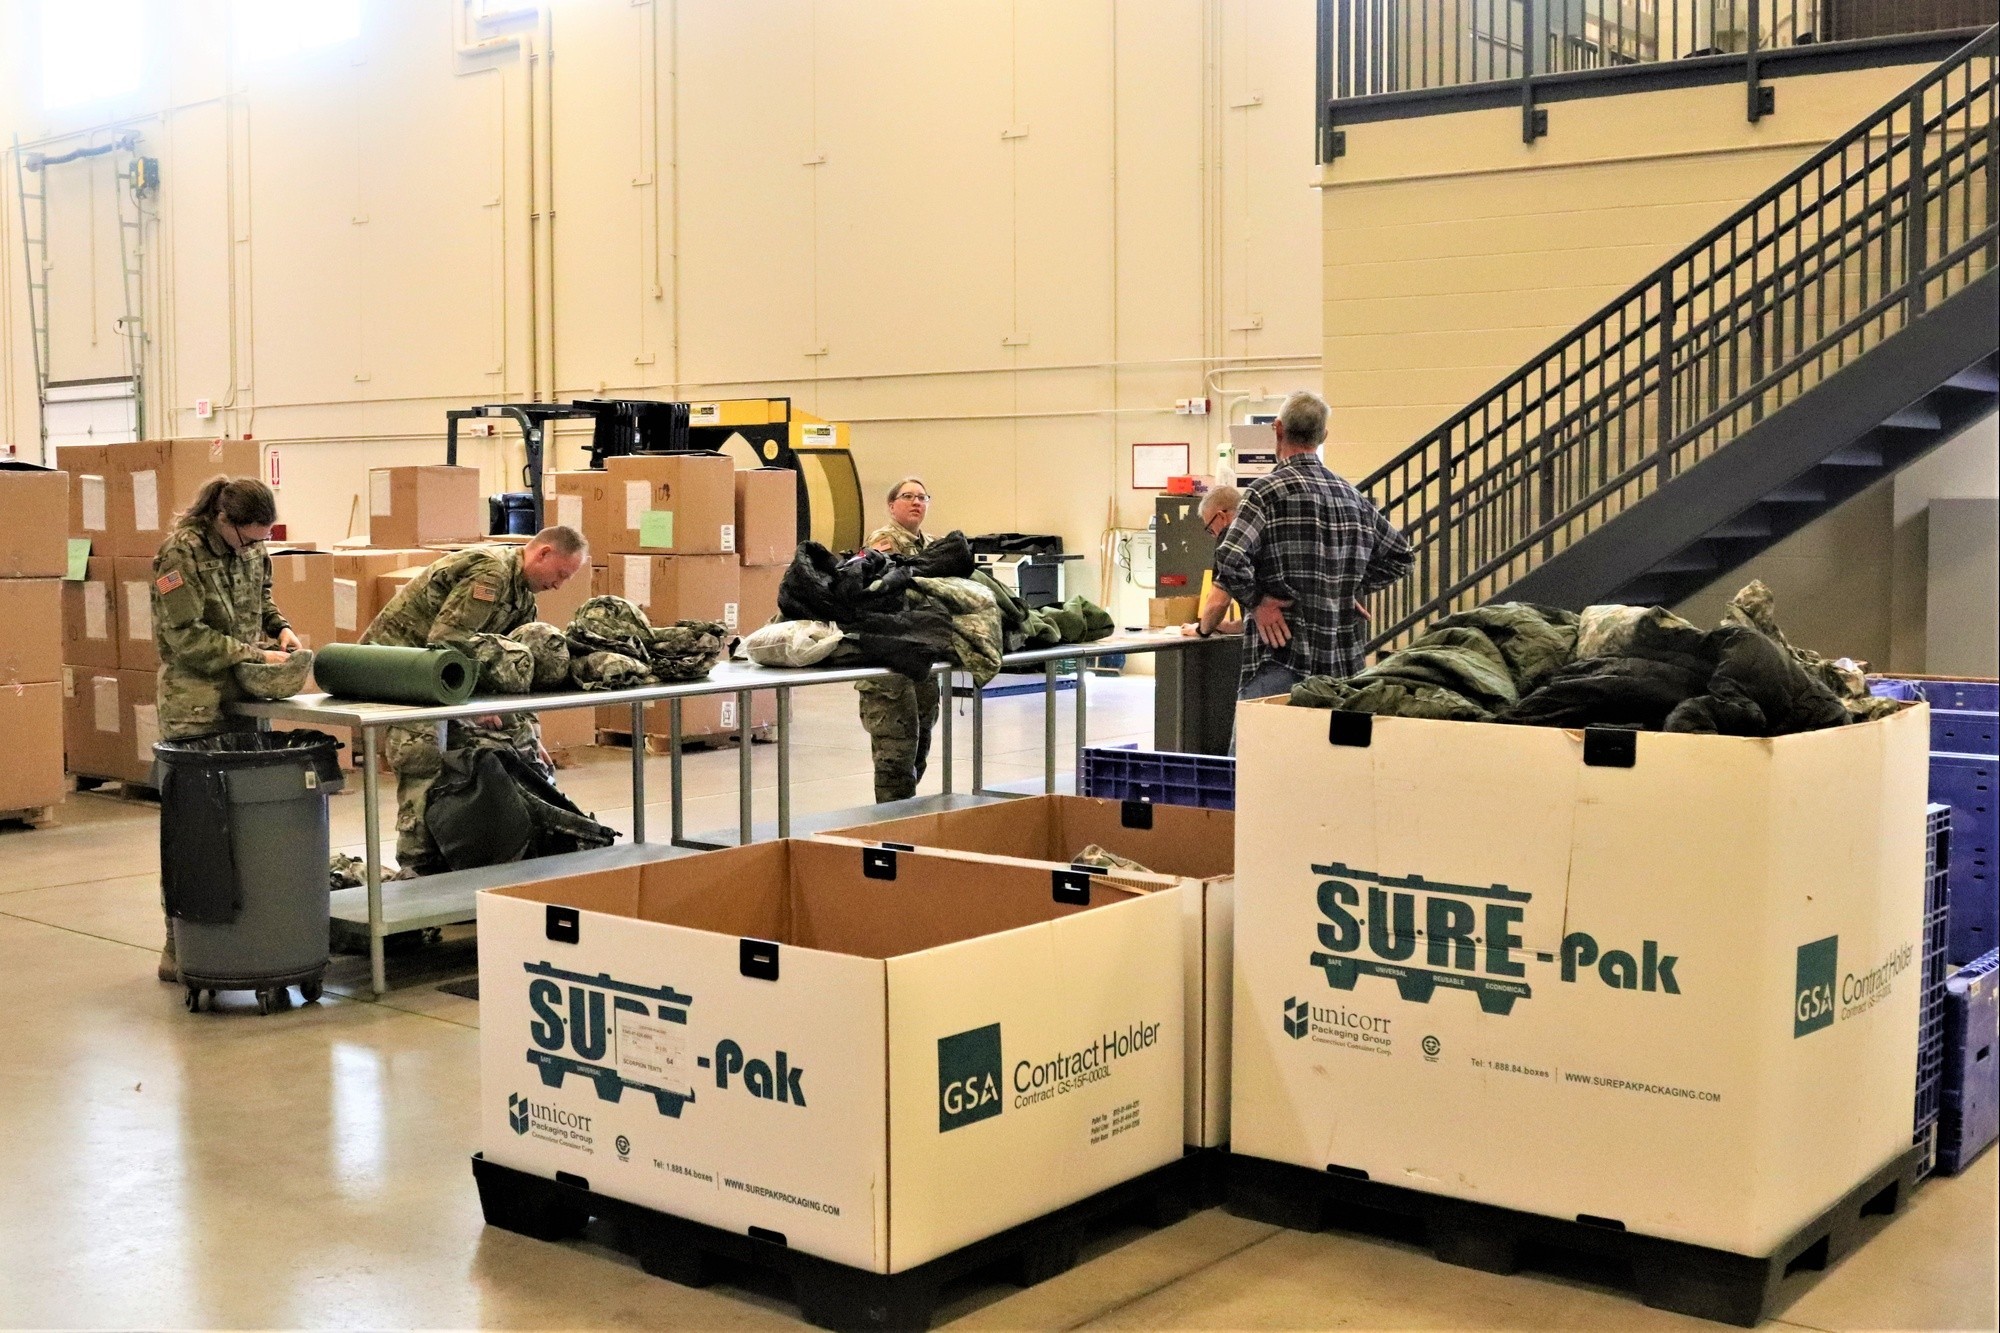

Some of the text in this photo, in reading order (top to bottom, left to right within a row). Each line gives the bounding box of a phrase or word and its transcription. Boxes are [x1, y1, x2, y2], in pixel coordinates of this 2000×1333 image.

[1327, 958, 1342, 967] SAFE
[1375, 966, 1407, 978] UNIVERSAL
[1433, 975, 1465, 987] REUSABLE
[1485, 982, 1526, 995] ECONOMICAL
[1797, 982, 1833, 1022] GSA
[1312, 1005, 1391, 1034] unicorr
[1311, 1024, 1392, 1046] Packaging Group
[1013, 1020, 1160, 1094] Contract Holder
[943, 1072, 999, 1115] GSA
[1471, 1058, 1721, 1103] Tel: 1.888.84.boxes WWW.SUREPAKPACKAGING.COM
[1014, 1086, 1055, 1110] Contract
[531, 1102, 592, 1132] unicorr
[531, 1120, 593, 1145] Packaging Group
[653, 1159, 840, 1217] Tel: 1.888.84.boxes WWW.SUREPAKPACKAGING.COM
